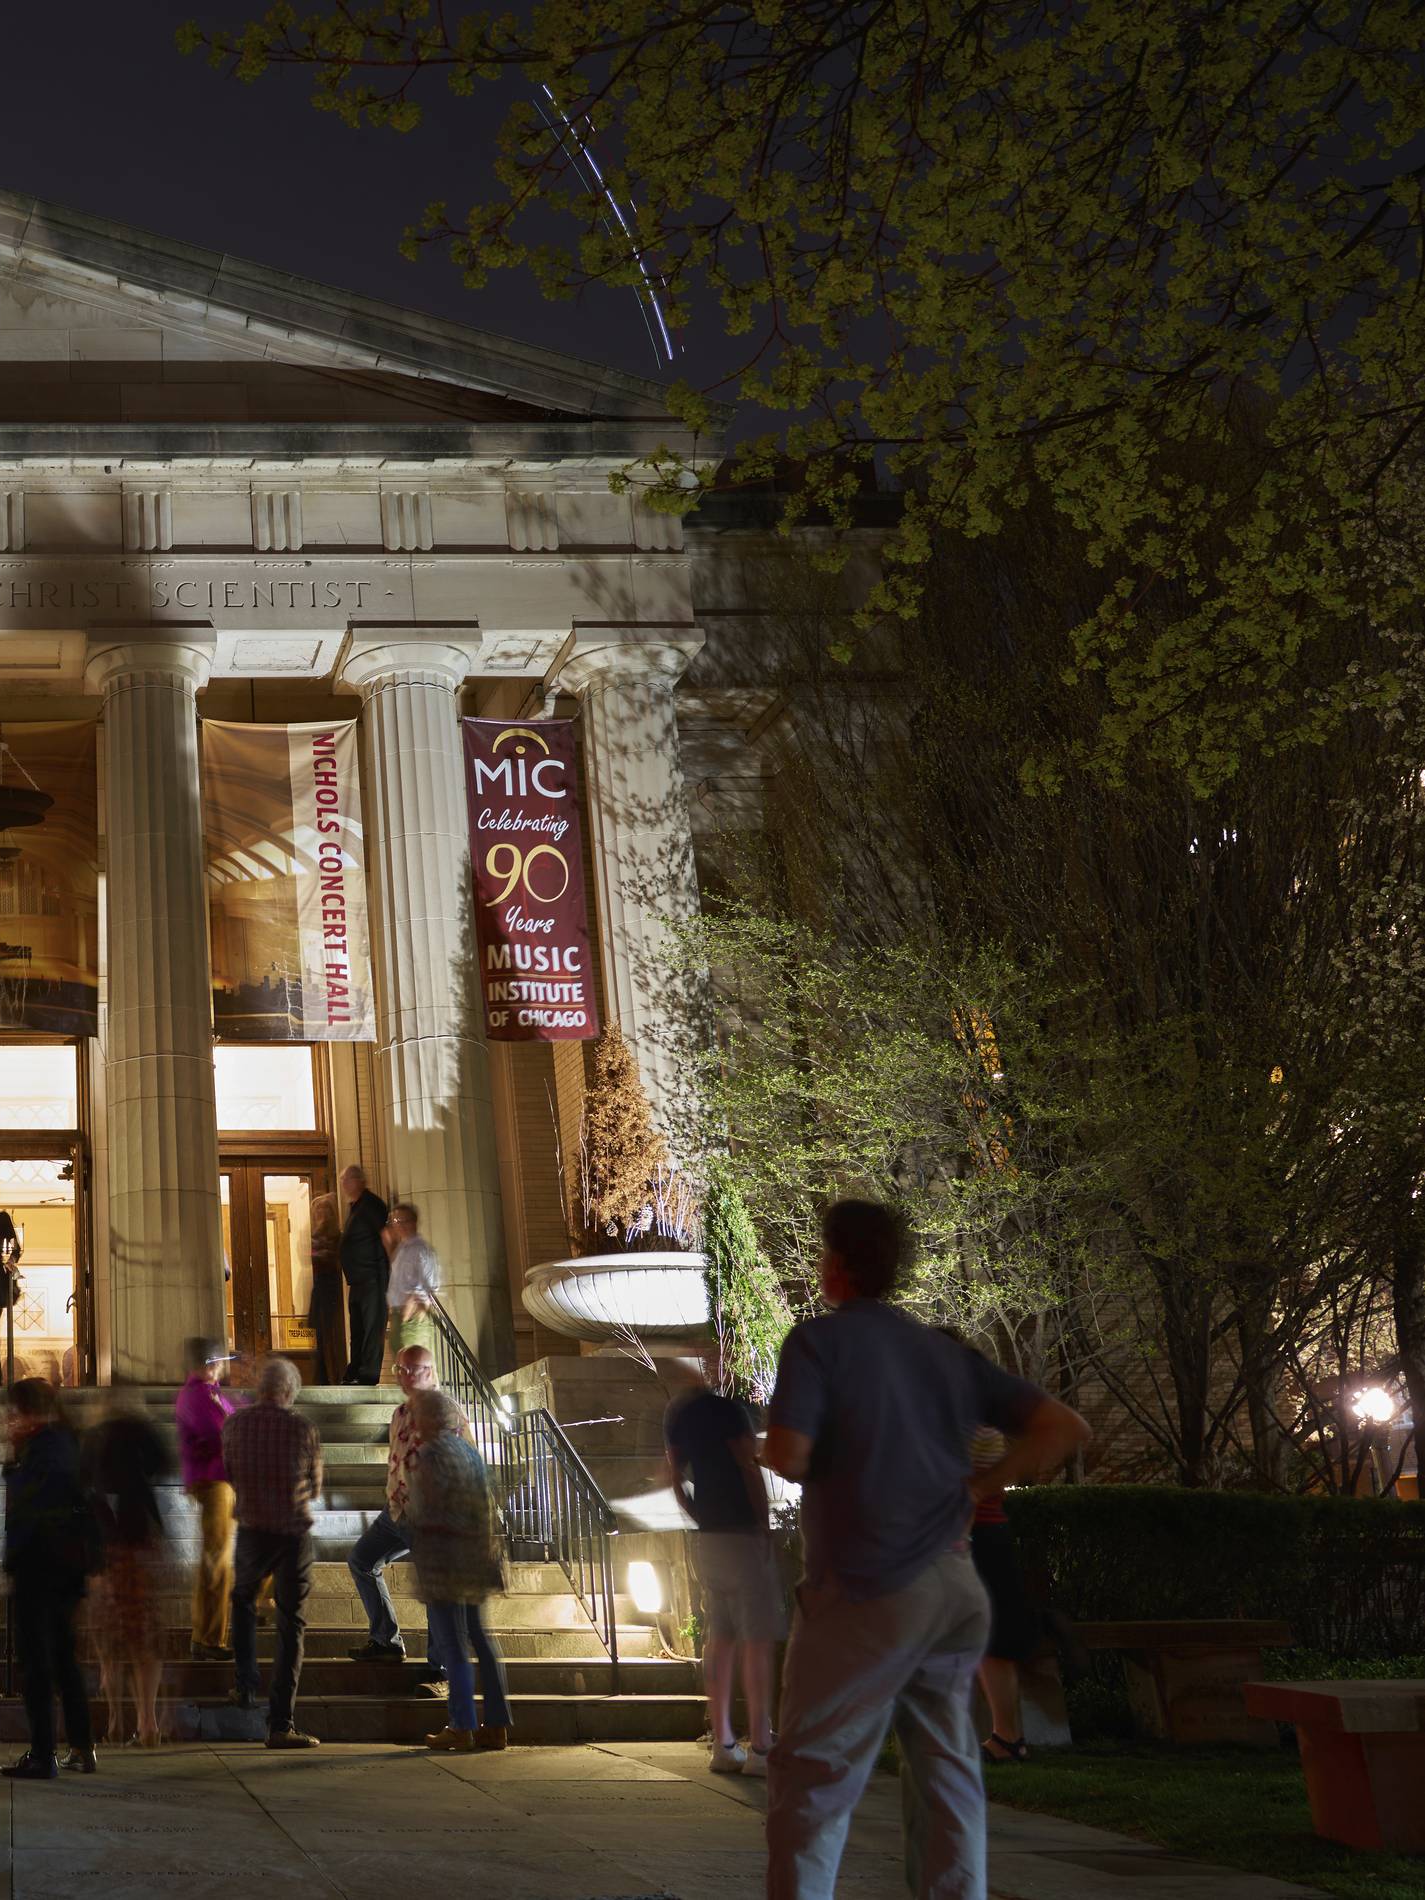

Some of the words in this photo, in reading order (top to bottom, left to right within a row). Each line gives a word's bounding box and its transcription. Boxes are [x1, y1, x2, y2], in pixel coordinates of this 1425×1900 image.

[151, 581, 372, 608] SCIENTIST
[312, 732, 340, 833] NICHOLS
[477, 807, 569, 840] Celebrating
[485, 843, 569, 907] 90
[319, 842, 347, 954] CONCERT
[505, 905, 555, 933] Years
[487, 944, 581, 972] MUSIC
[325, 963, 351, 1026] HALL
[487, 981, 585, 1003] INSTITUTE
[489, 1010, 510, 1027] OF
[518, 1009, 587, 1028] CHICAGO
